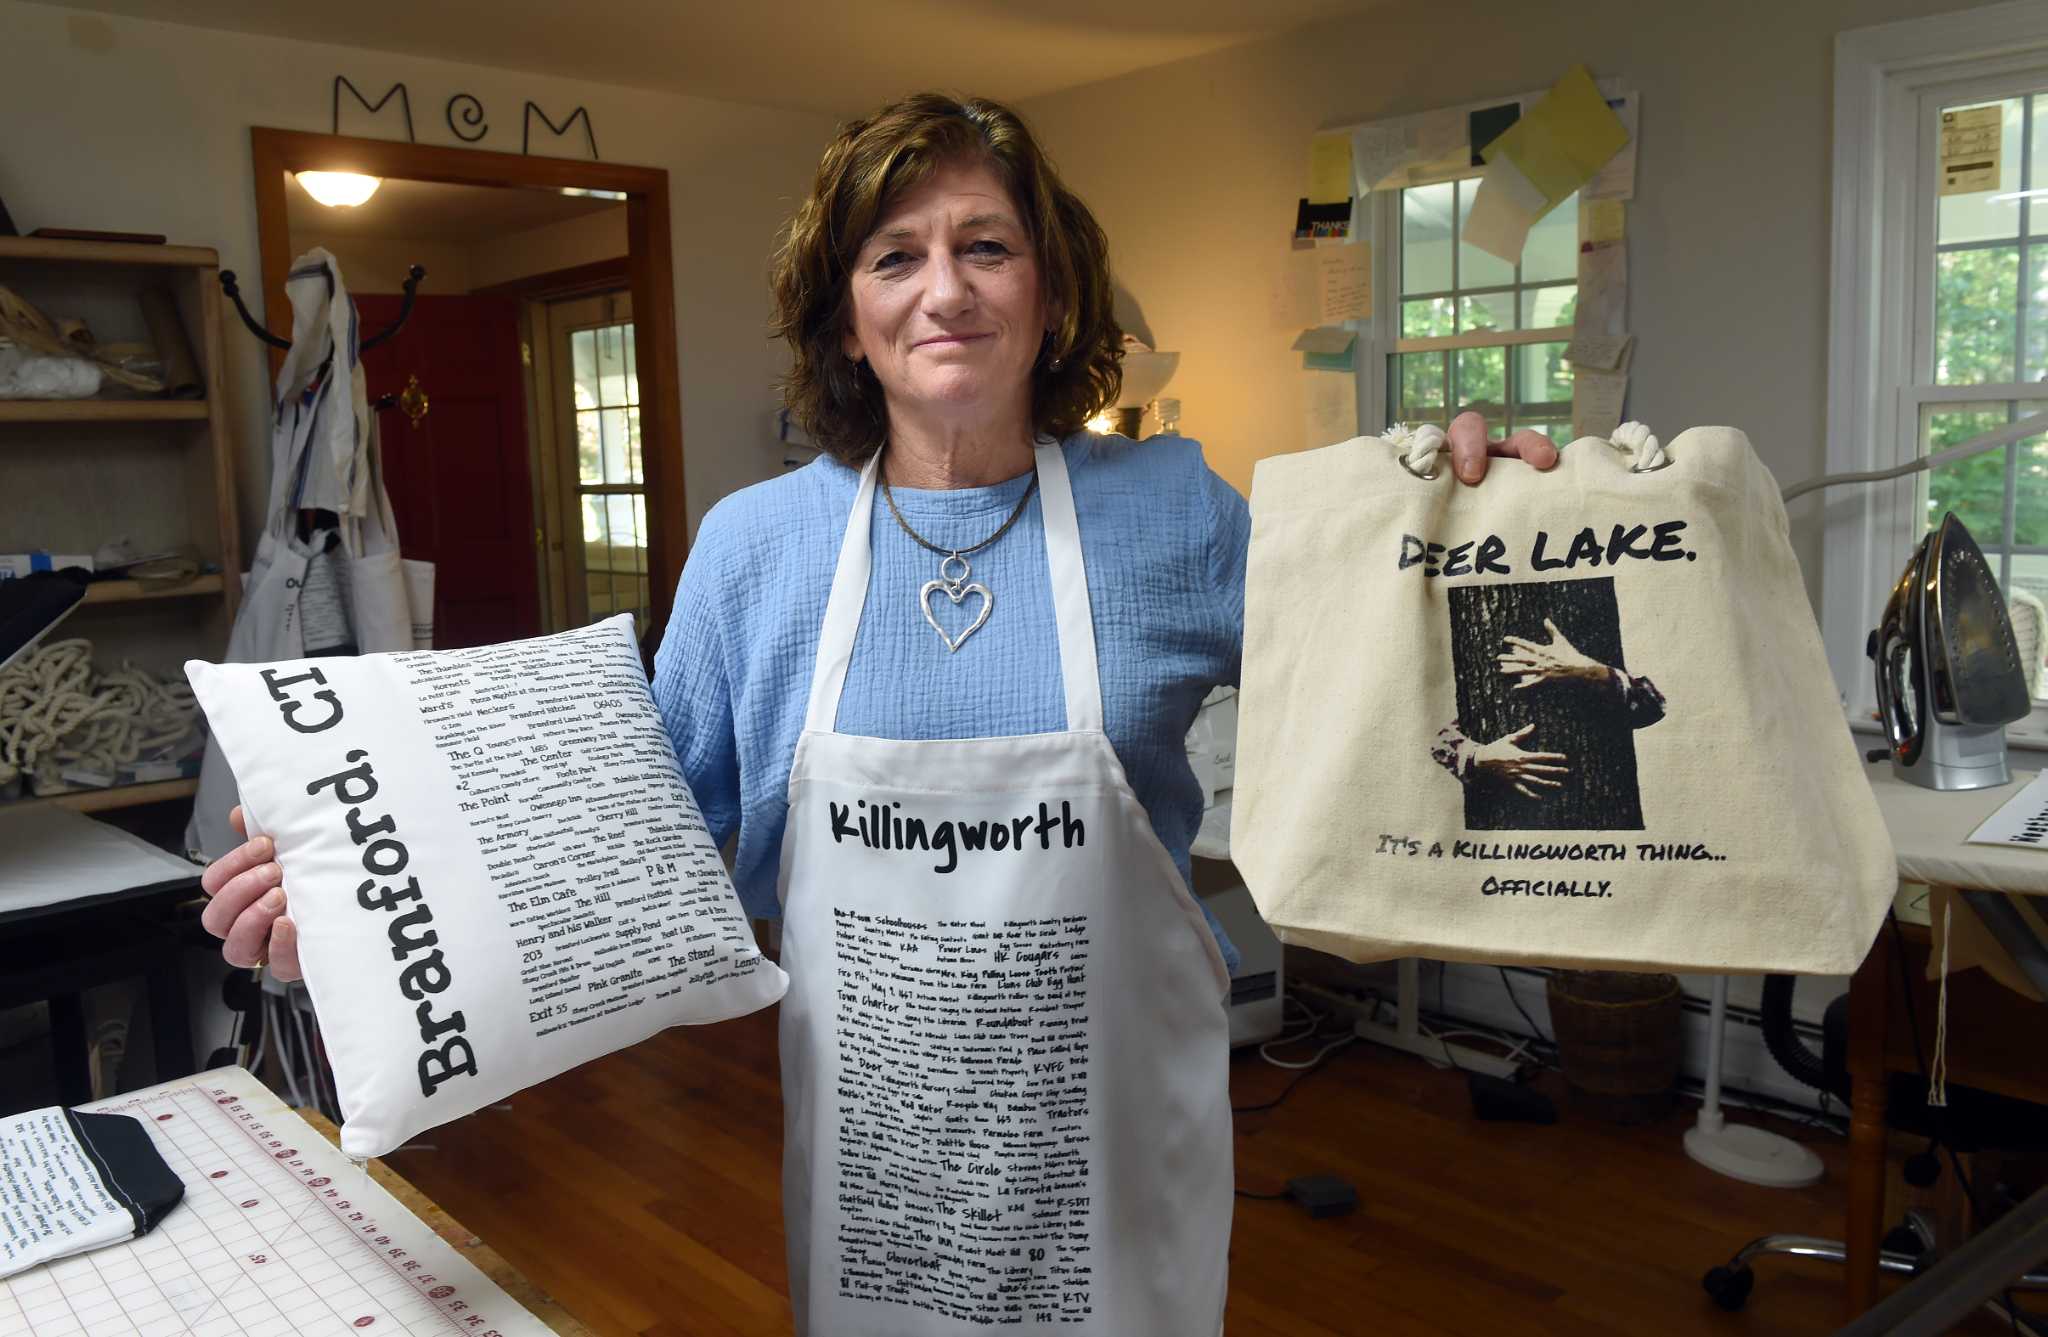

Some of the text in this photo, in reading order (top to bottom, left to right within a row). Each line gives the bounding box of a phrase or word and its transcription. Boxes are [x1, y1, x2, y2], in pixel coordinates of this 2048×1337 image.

[1398, 520, 1697, 577] DEER LAKE.
[260, 667, 343, 733] CT
[448, 745, 485, 763] The Q
[520, 756, 542, 767] The
[457, 791, 512, 813] The Point
[830, 800, 1085, 874] Killingworth
[1427, 843, 1443, 858] A
[1452, 839, 1626, 861] KILLINGWORTH
[1481, 875, 1614, 898] OFFICIALLY.
[507, 888, 578, 913] The Elm Cafe
[574, 890, 612, 909] The Hill
[306, 749, 478, 1098] Branford,
[515, 932, 547, 949] Henry
[547, 927, 567, 940] and
[566, 922, 584, 935] his
[521, 949, 545, 964] 203
[668, 944, 718, 969] The Stand
[837, 989, 901, 1014] Town Charter
[528, 1005, 555, 1024] Exit
[940, 1158, 1002, 1177] The Circle
[935, 1200, 1004, 1223] The Skillet
[913, 1227, 934, 1242] The
[388, 1248, 407, 1258] 39
[402, 1260, 422, 1271] 38
[417, 1274, 437, 1284] 37
[448, 1300, 469, 1312] 35
[464, 1315, 485, 1327] 34
